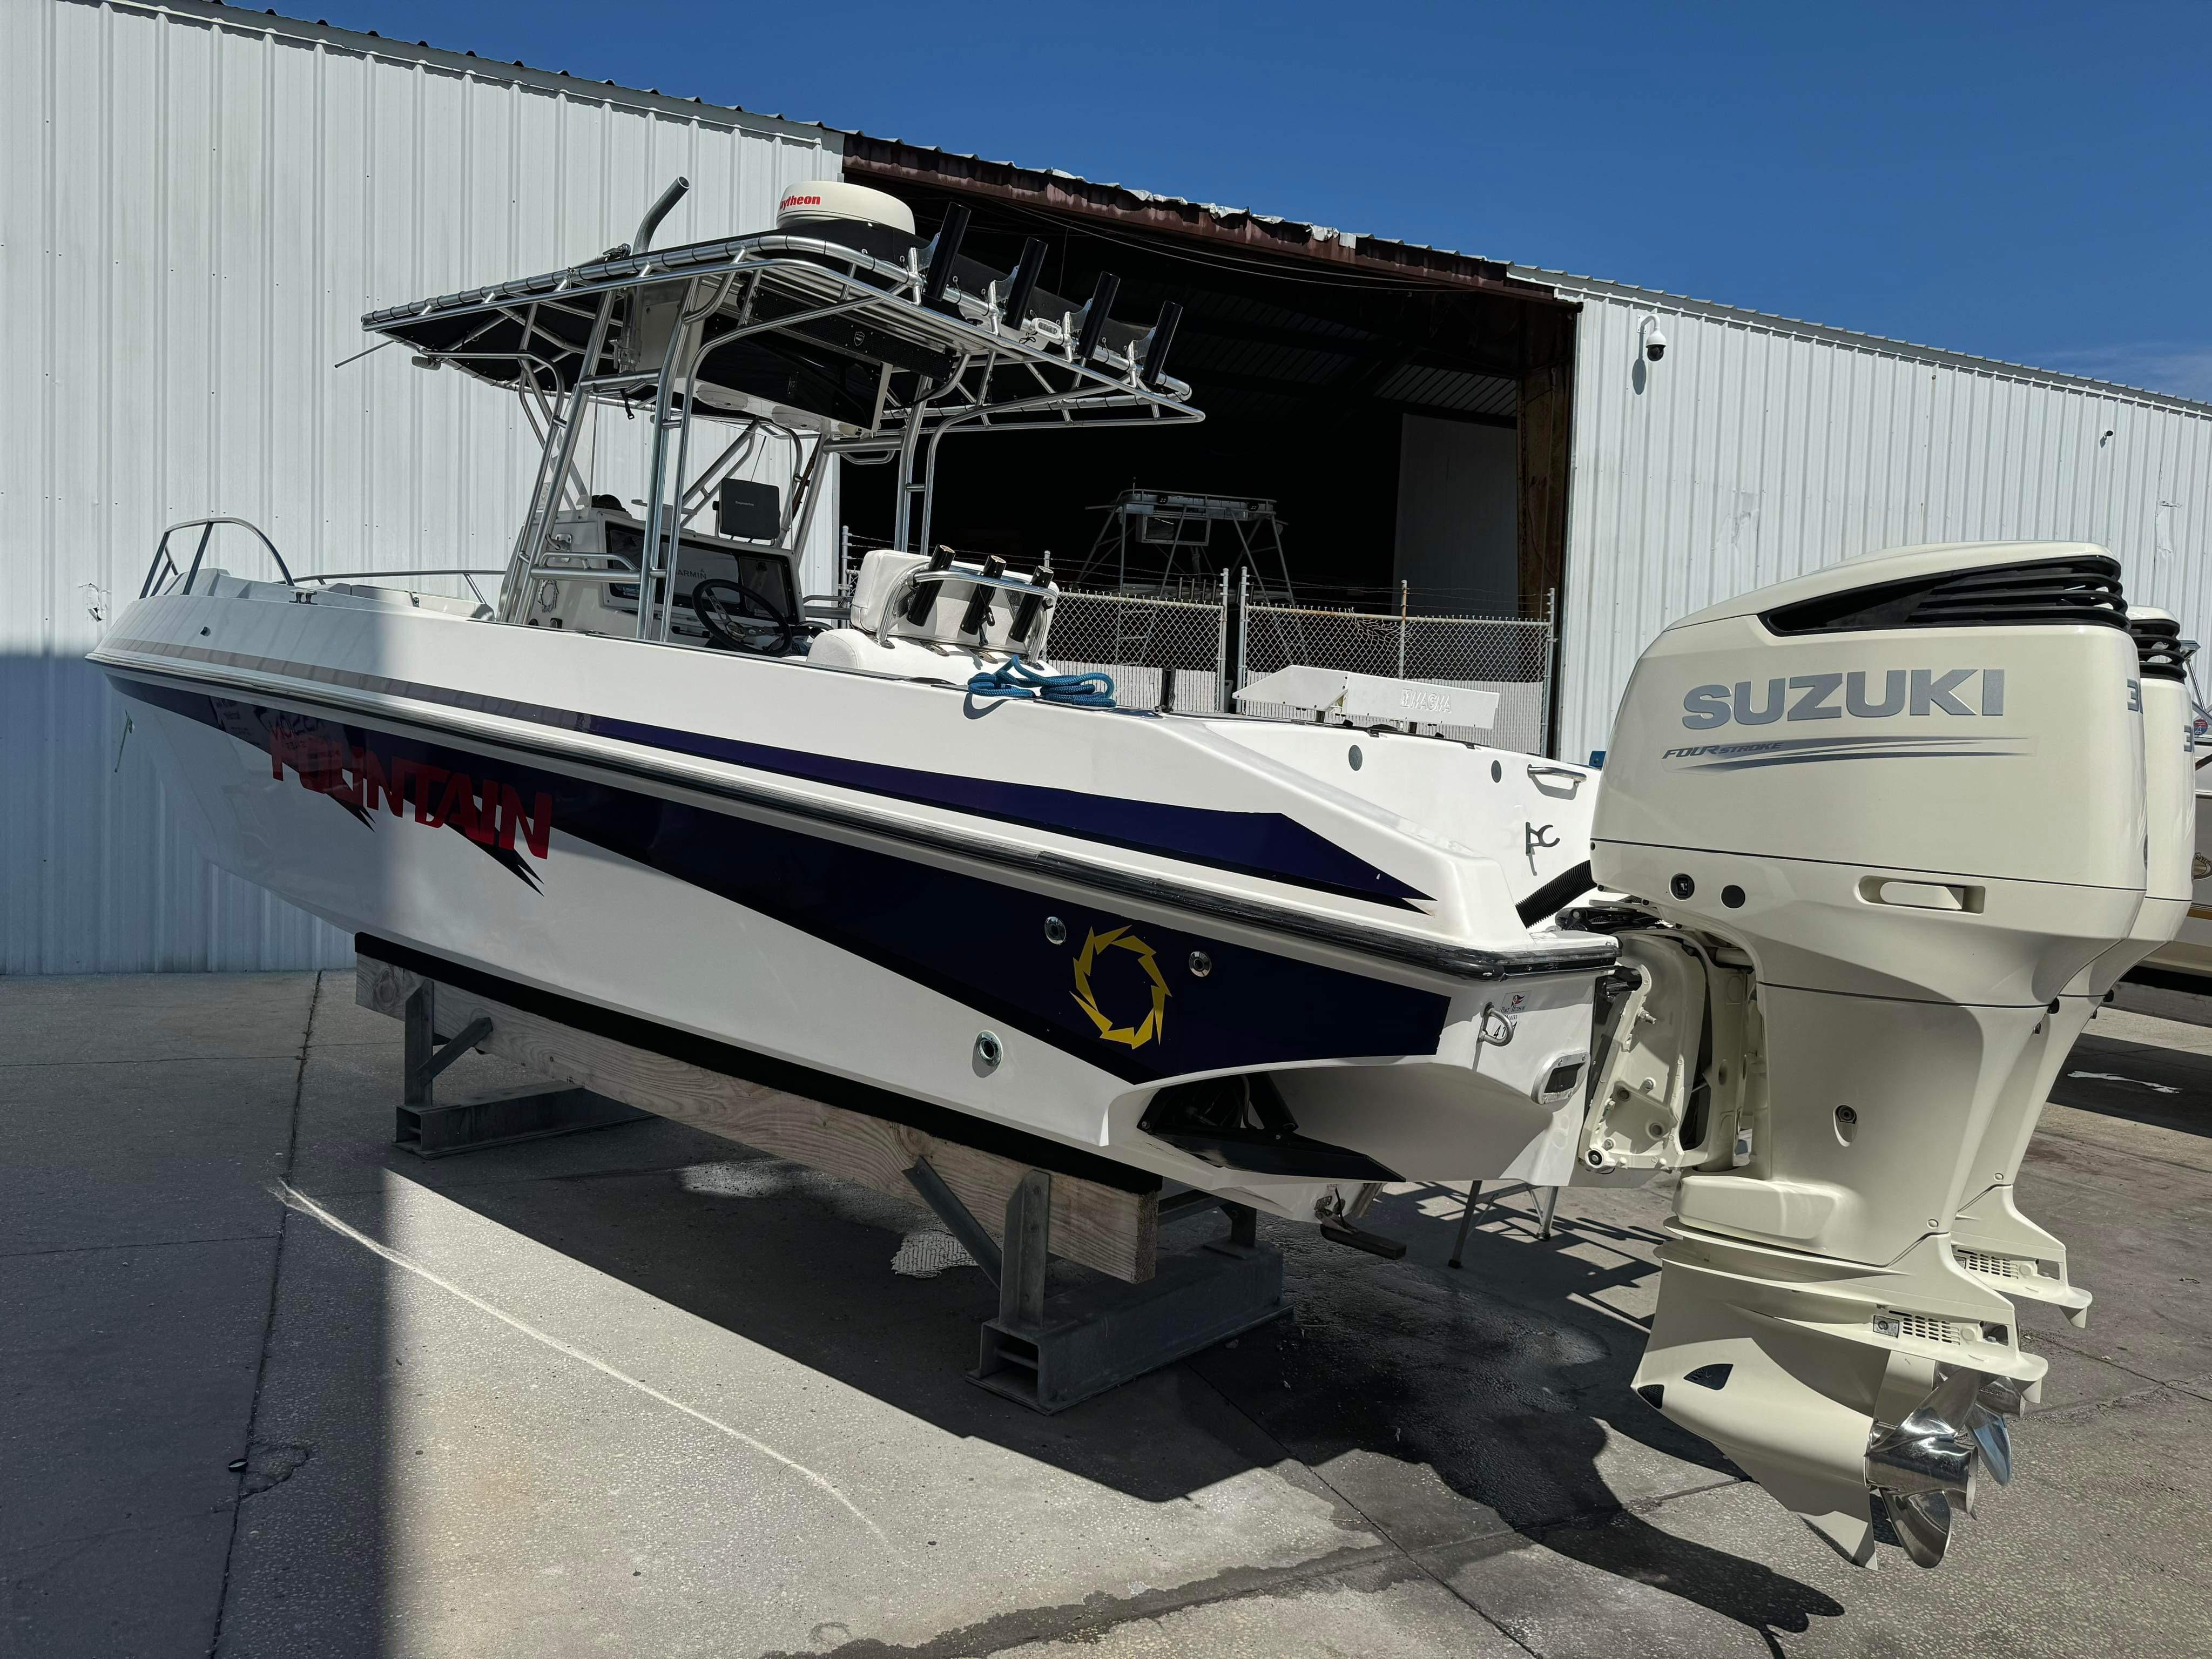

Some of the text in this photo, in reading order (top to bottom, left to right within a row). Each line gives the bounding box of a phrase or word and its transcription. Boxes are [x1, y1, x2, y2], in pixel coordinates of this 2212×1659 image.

[675, 568, 706, 579] ARMIN
[1410, 691, 1452, 713] MAGMA
[1681, 669, 2005, 730] SUZUKI
[1662, 742, 1784, 759] FOUR STROKE
